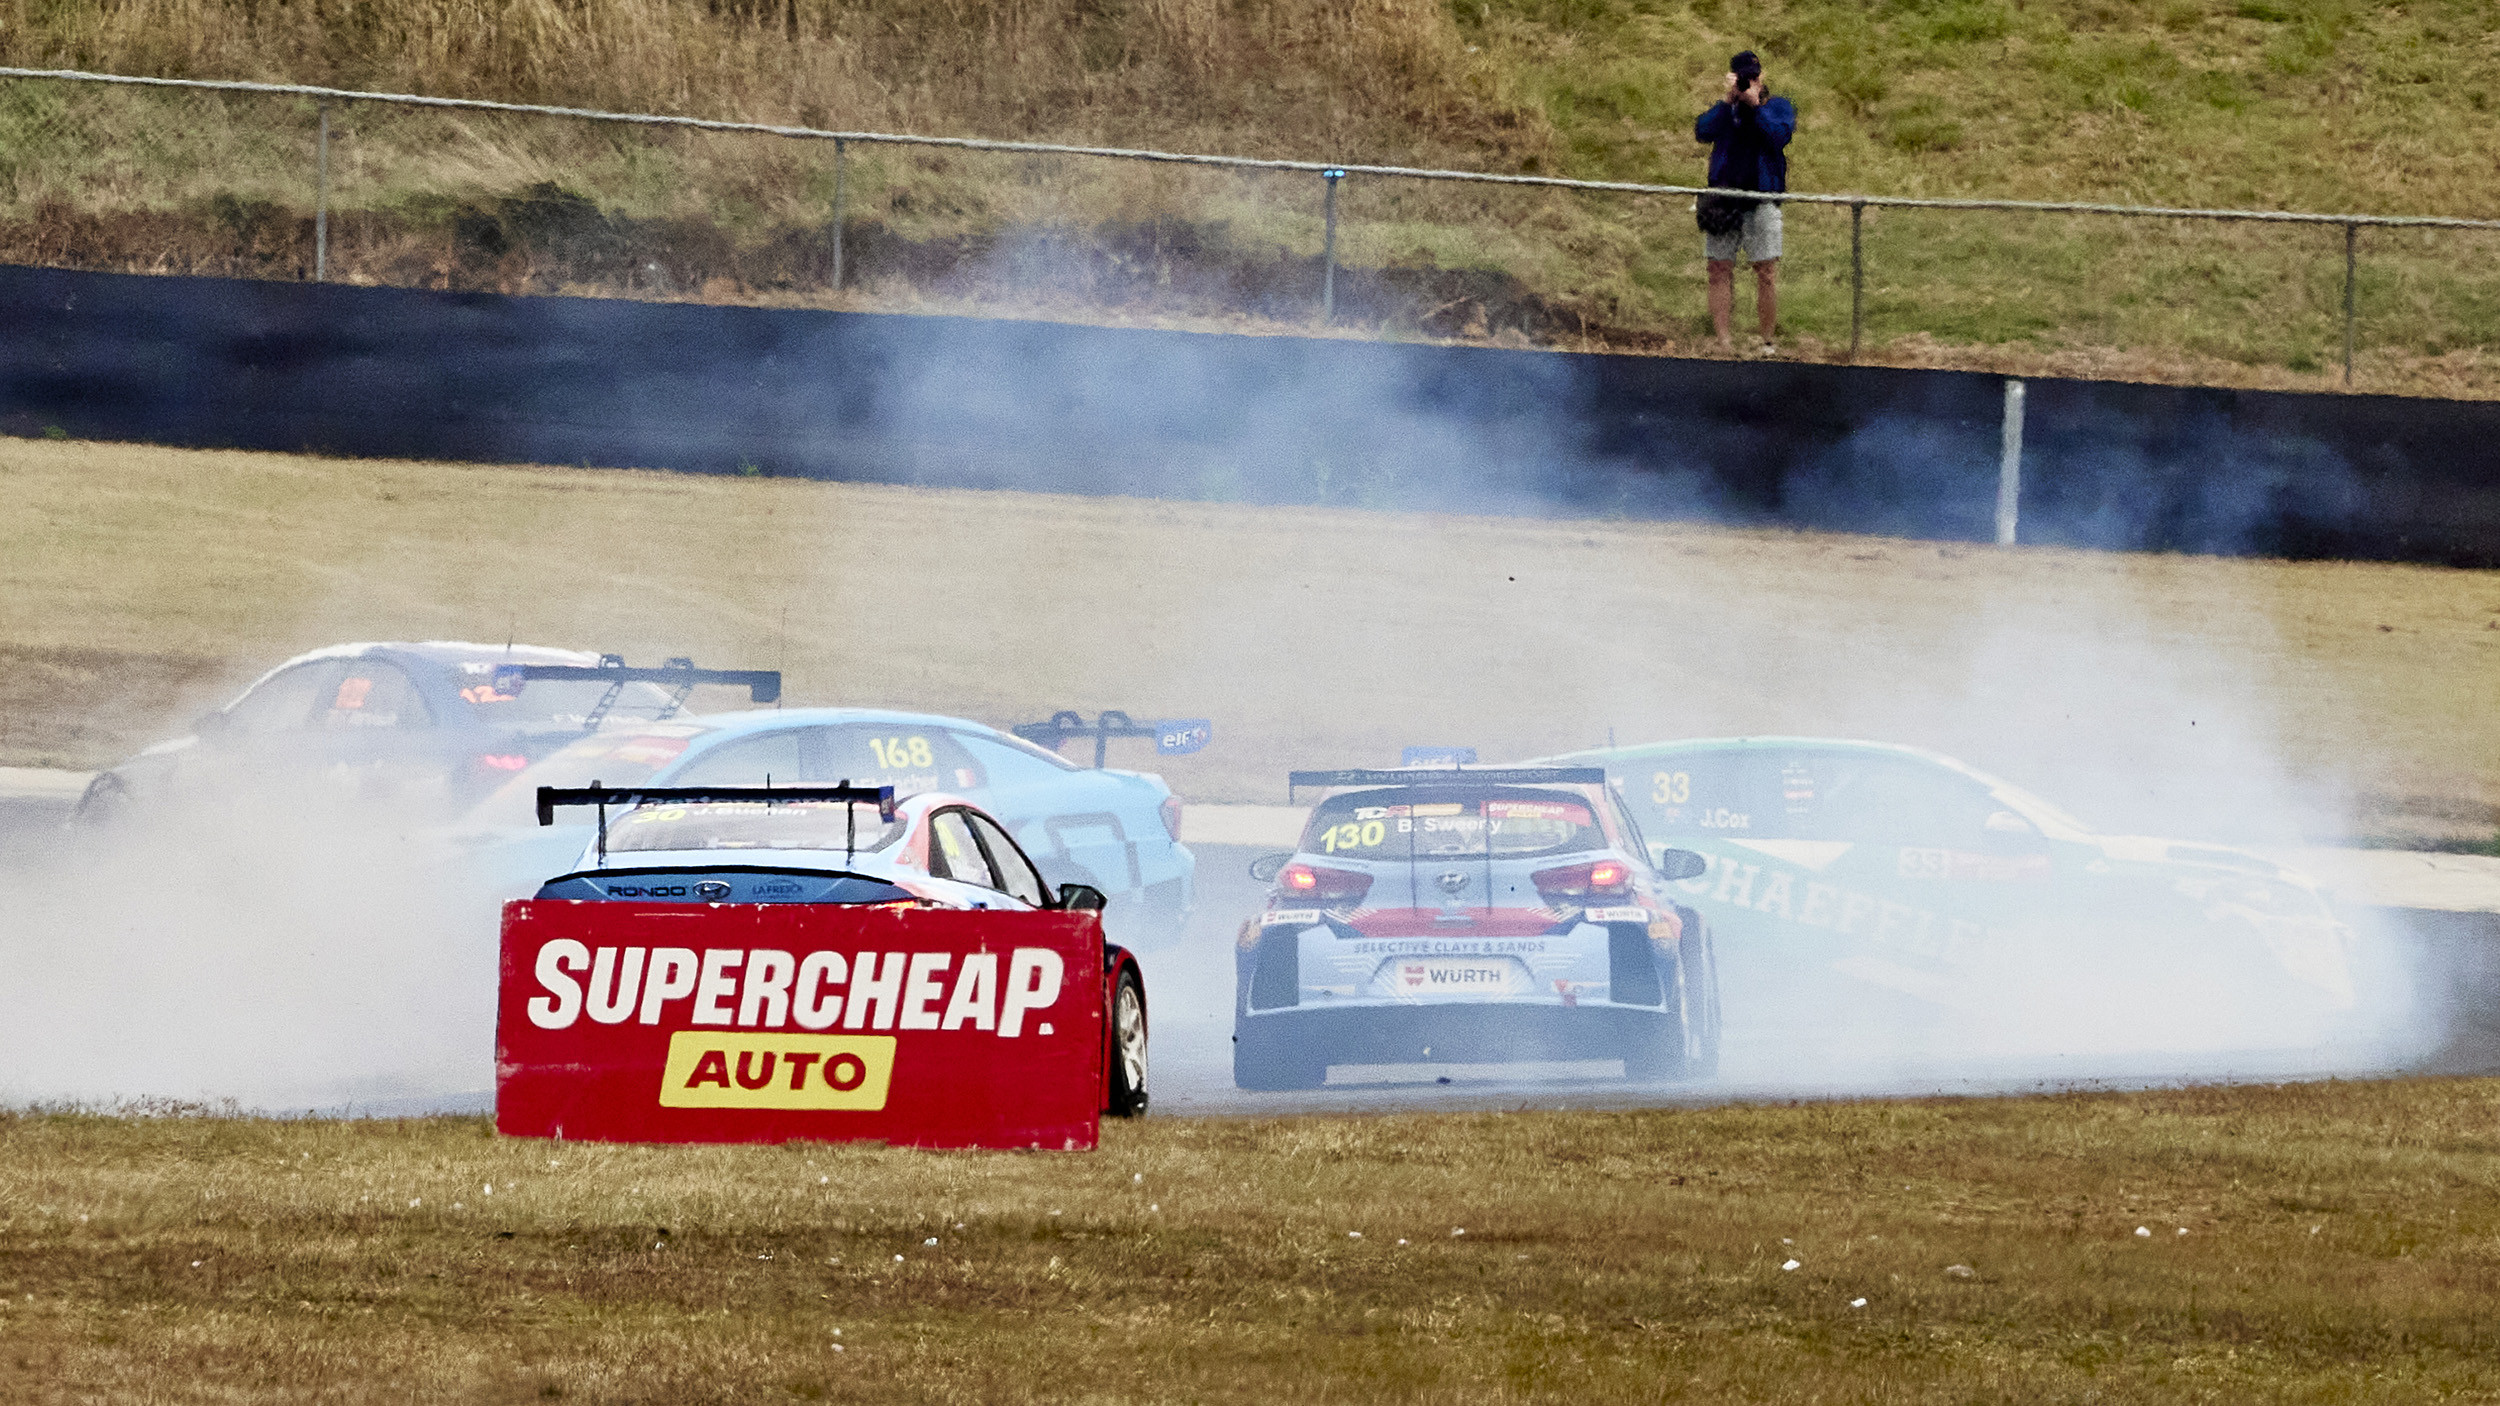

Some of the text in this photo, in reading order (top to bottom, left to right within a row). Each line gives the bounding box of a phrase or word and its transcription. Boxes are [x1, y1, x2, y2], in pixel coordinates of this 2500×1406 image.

[1163, 730, 1191, 747] elf
[868, 736, 933, 769] 168
[1652, 772, 1690, 804] 33
[632, 808, 687, 824] 30
[1320, 822, 1386, 854] 130
[608, 886, 686, 897] RONDO
[1430, 967, 1500, 983] WÜRTH
[685, 1050, 867, 1092] AUTO
